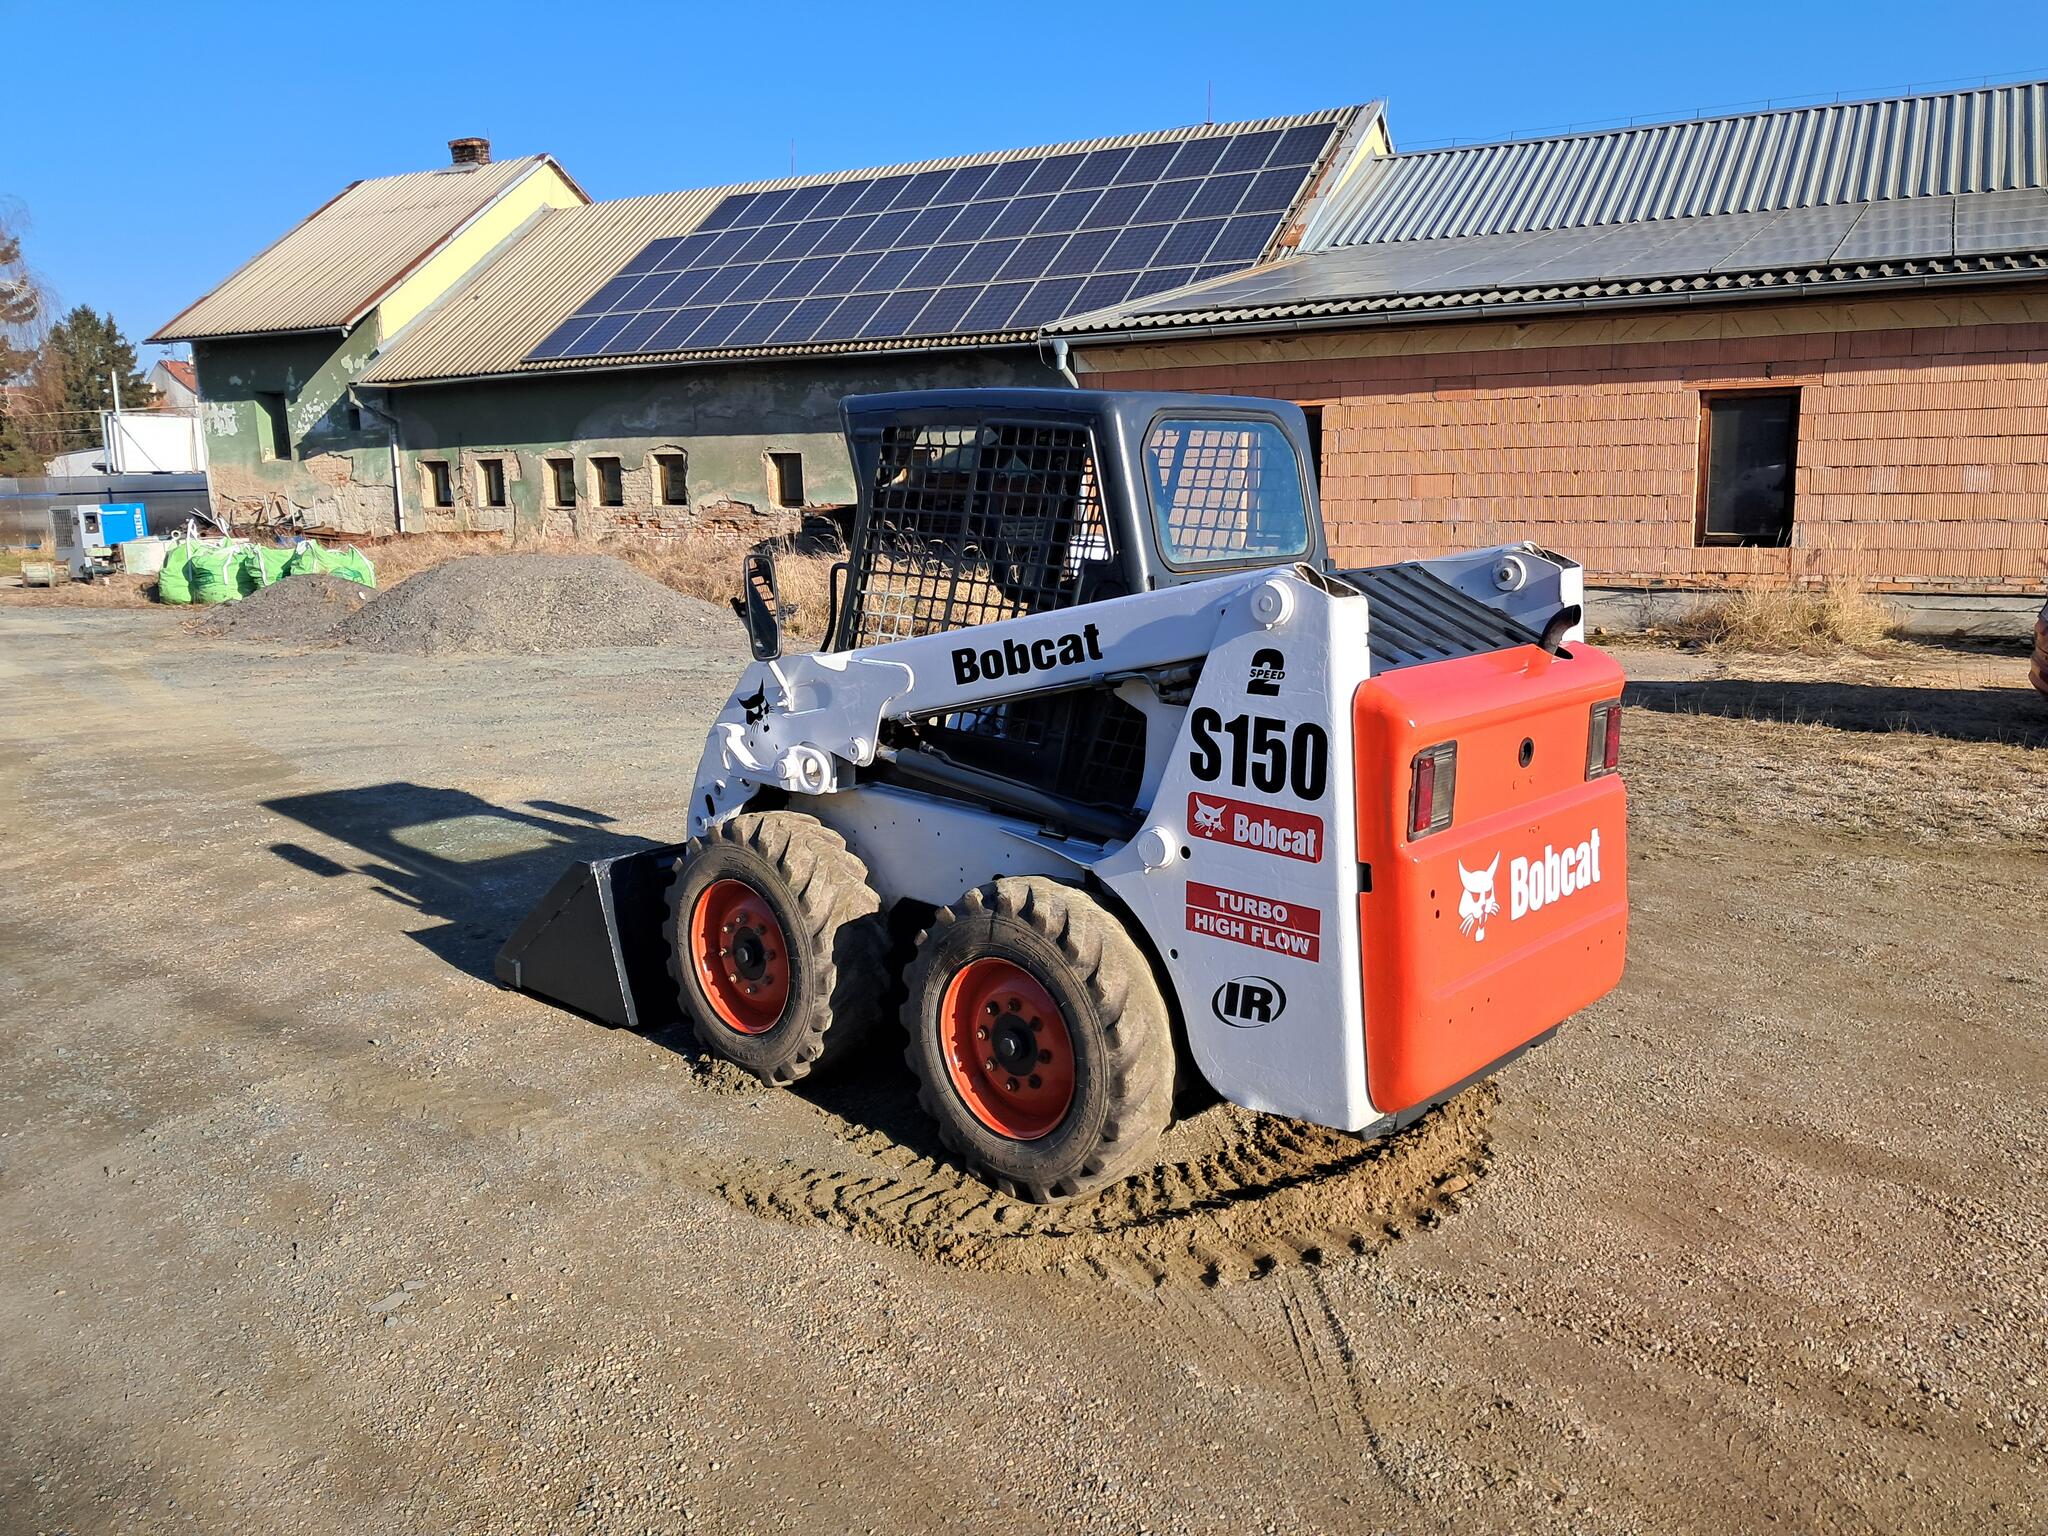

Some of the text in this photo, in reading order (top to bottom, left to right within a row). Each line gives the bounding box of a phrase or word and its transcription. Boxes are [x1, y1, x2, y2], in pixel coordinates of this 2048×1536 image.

[951, 623, 1103, 686] Bobcat
[1246, 647, 1285, 696] 2
[1248, 667, 1285, 680] SPEED
[1189, 706, 1329, 801] S150
[1233, 812, 1317, 860] Bobcat
[1510, 827, 1601, 921] Bobcat
[1215, 890, 1289, 923] TURBO
[1194, 912, 1311, 956] HIGH FLOW
[1223, 981, 1275, 1023] IR
